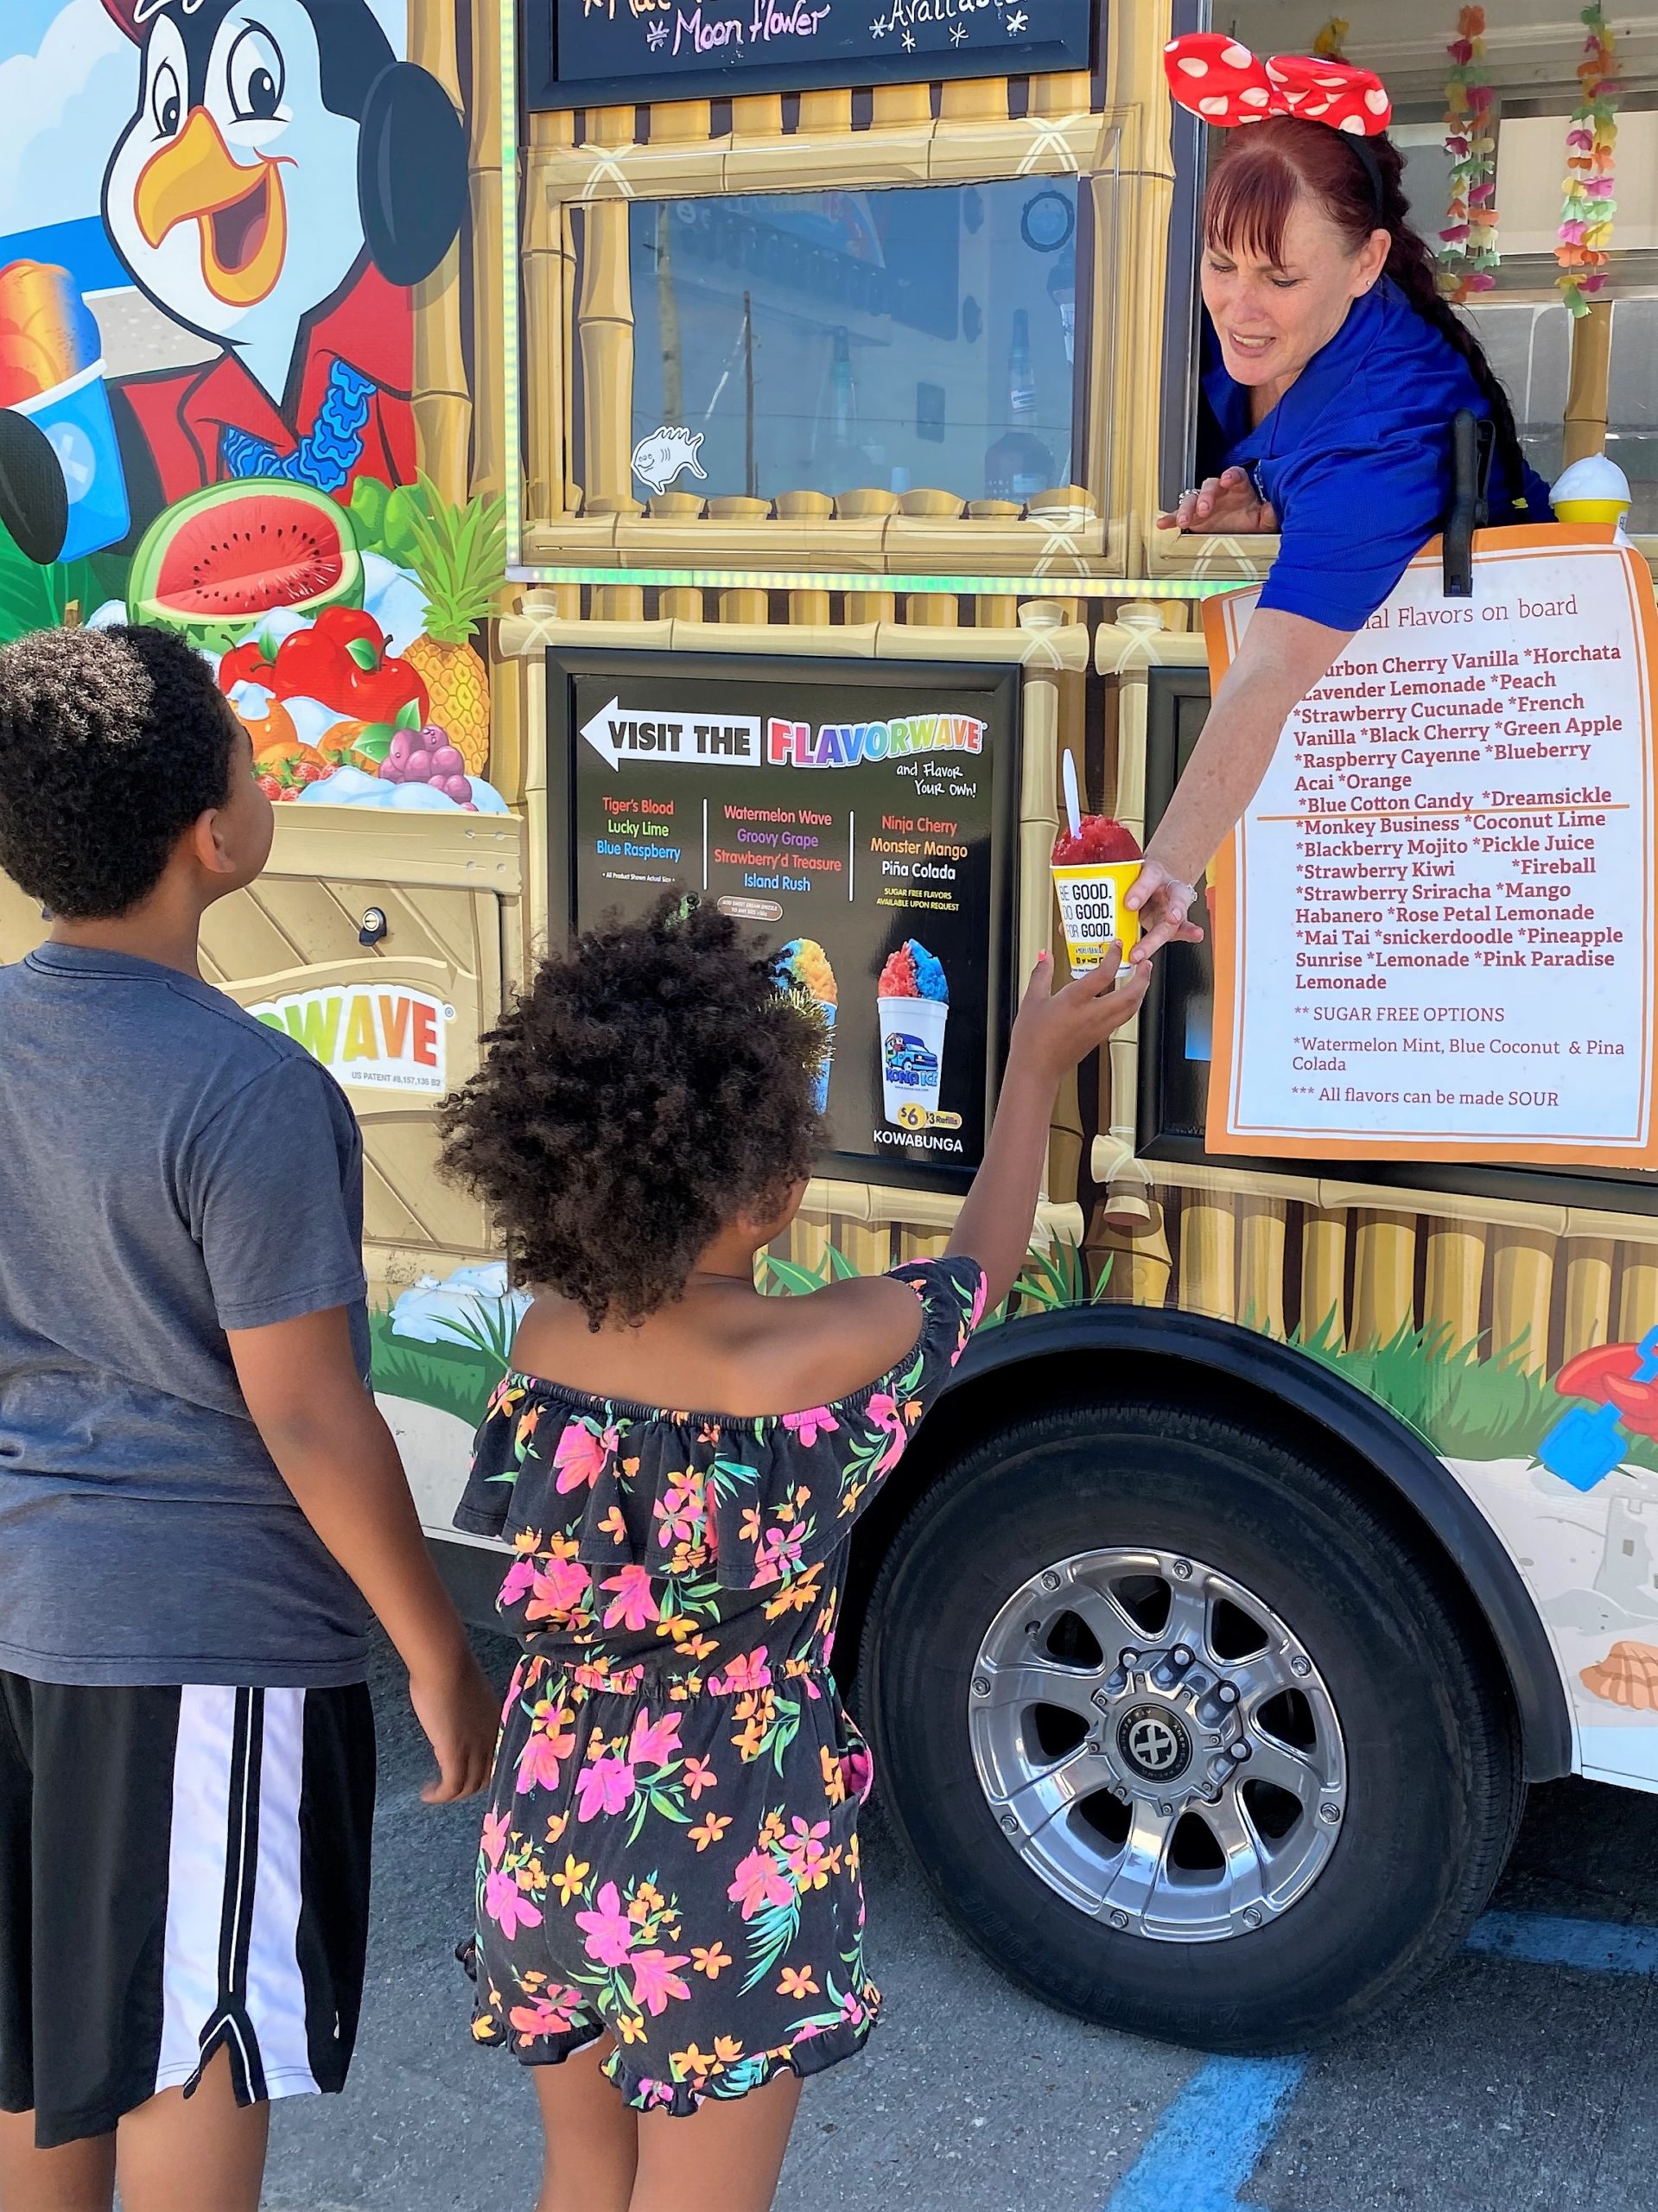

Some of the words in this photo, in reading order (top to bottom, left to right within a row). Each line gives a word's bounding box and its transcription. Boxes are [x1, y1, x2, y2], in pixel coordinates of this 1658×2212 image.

[671, 8, 744, 55] Moon
[1397, 606, 1474, 628] Flavors
[1481, 606, 1510, 621] on
[1516, 594, 1579, 619] board
[1382, 656, 1449, 676] Cherry
[1451, 649, 1521, 670] Vanilla
[1388, 675, 1486, 697] Lemonade
[1410, 697, 1504, 719] Cucunade
[1293, 728, 1357, 747] Vanilla
[1423, 722, 1491, 742] Cherry
[1564, 714, 1623, 738] Apple
[608, 721, 683, 752] VISIT
[694, 726, 751, 755] THE
[772, 718, 981, 765] FLAVORWAVE
[1401, 748, 1481, 768] Cayenne
[897, 762, 918, 776] and
[1293, 773, 1335, 791] Acai
[602, 798, 638, 814] Tiger's
[641, 799, 674, 815] Blood
[1350, 795, 1411, 812] Cotton
[1414, 793, 1473, 811] Candy
[724, 805, 795, 823] Watermelon
[798, 810, 832, 826] Wave
[1380, 816, 1459, 833] Business
[1557, 812, 1605, 829] Lime
[607, 819, 638, 837] Lucky
[642, 822, 670, 836] Lime
[881, 816, 916, 834] Ninja
[918, 818, 957, 836] Cherry
[737, 829, 778, 847] Groovy
[781, 832, 818, 849] Grape
[1407, 837, 1469, 859] Mojito
[1543, 833, 1595, 852] Juice
[597, 840, 621, 857] Blue
[624, 842, 682, 863] Raspberry
[871, 839, 921, 856] Monster
[924, 842, 968, 860] Mango
[714, 849, 789, 871] Strawberry'd
[791, 854, 842, 871] Treasure
[1411, 860, 1456, 878] Kiwi
[881, 861, 909, 878] Piña
[912, 864, 956, 880] Colada
[744, 873, 778, 890] Island
[779, 875, 811, 892] Rush
[1072, 883, 1112, 899] GOOD.
[1412, 882, 1492, 900] Sriracha
[876, 898, 909, 906] AVAILABLE
[931, 902, 959, 911] REQUEST
[1076, 903, 1113, 919] GOOD.
[1294, 907, 1383, 924] Habanero
[1442, 905, 1492, 922] Petal
[1494, 903, 1595, 922] Lemonade
[1081, 923, 1113, 937] GOOD.
[1341, 928, 1371, 945] Tai
[1295, 950, 1363, 968] Sunrise
[1530, 949, 1616, 968] Paradise
[1294, 973, 1388, 990] Lemonade
[1313, 1006, 1373, 1022] SUGAR
[1375, 1007, 1420, 1022] FREE
[1423, 1007, 1505, 1022] OPTIONS
[1401, 1038, 1445, 1055] Mint,
[1448, 1038, 1486, 1053] Blue
[1489, 1039, 1561, 1055] Coconut
[1568, 1040, 1582, 1055] &
[1585, 1039, 1625, 1055] Pina
[1292, 1055, 1347, 1071] Colada
[364, 1072, 391, 1082] PATENT
[921, 1071, 938, 1086] ICE
[1318, 1086, 1342, 1102] All
[1344, 1087, 1400, 1103] flavors
[1402, 1092, 1432, 1104] can
[1435, 1089, 1456, 1104] be
[1458, 1090, 1504, 1106] made
[1508, 1090, 1560, 1107] SOUR
[873, 1130, 962, 1153] KOWABUNGA
